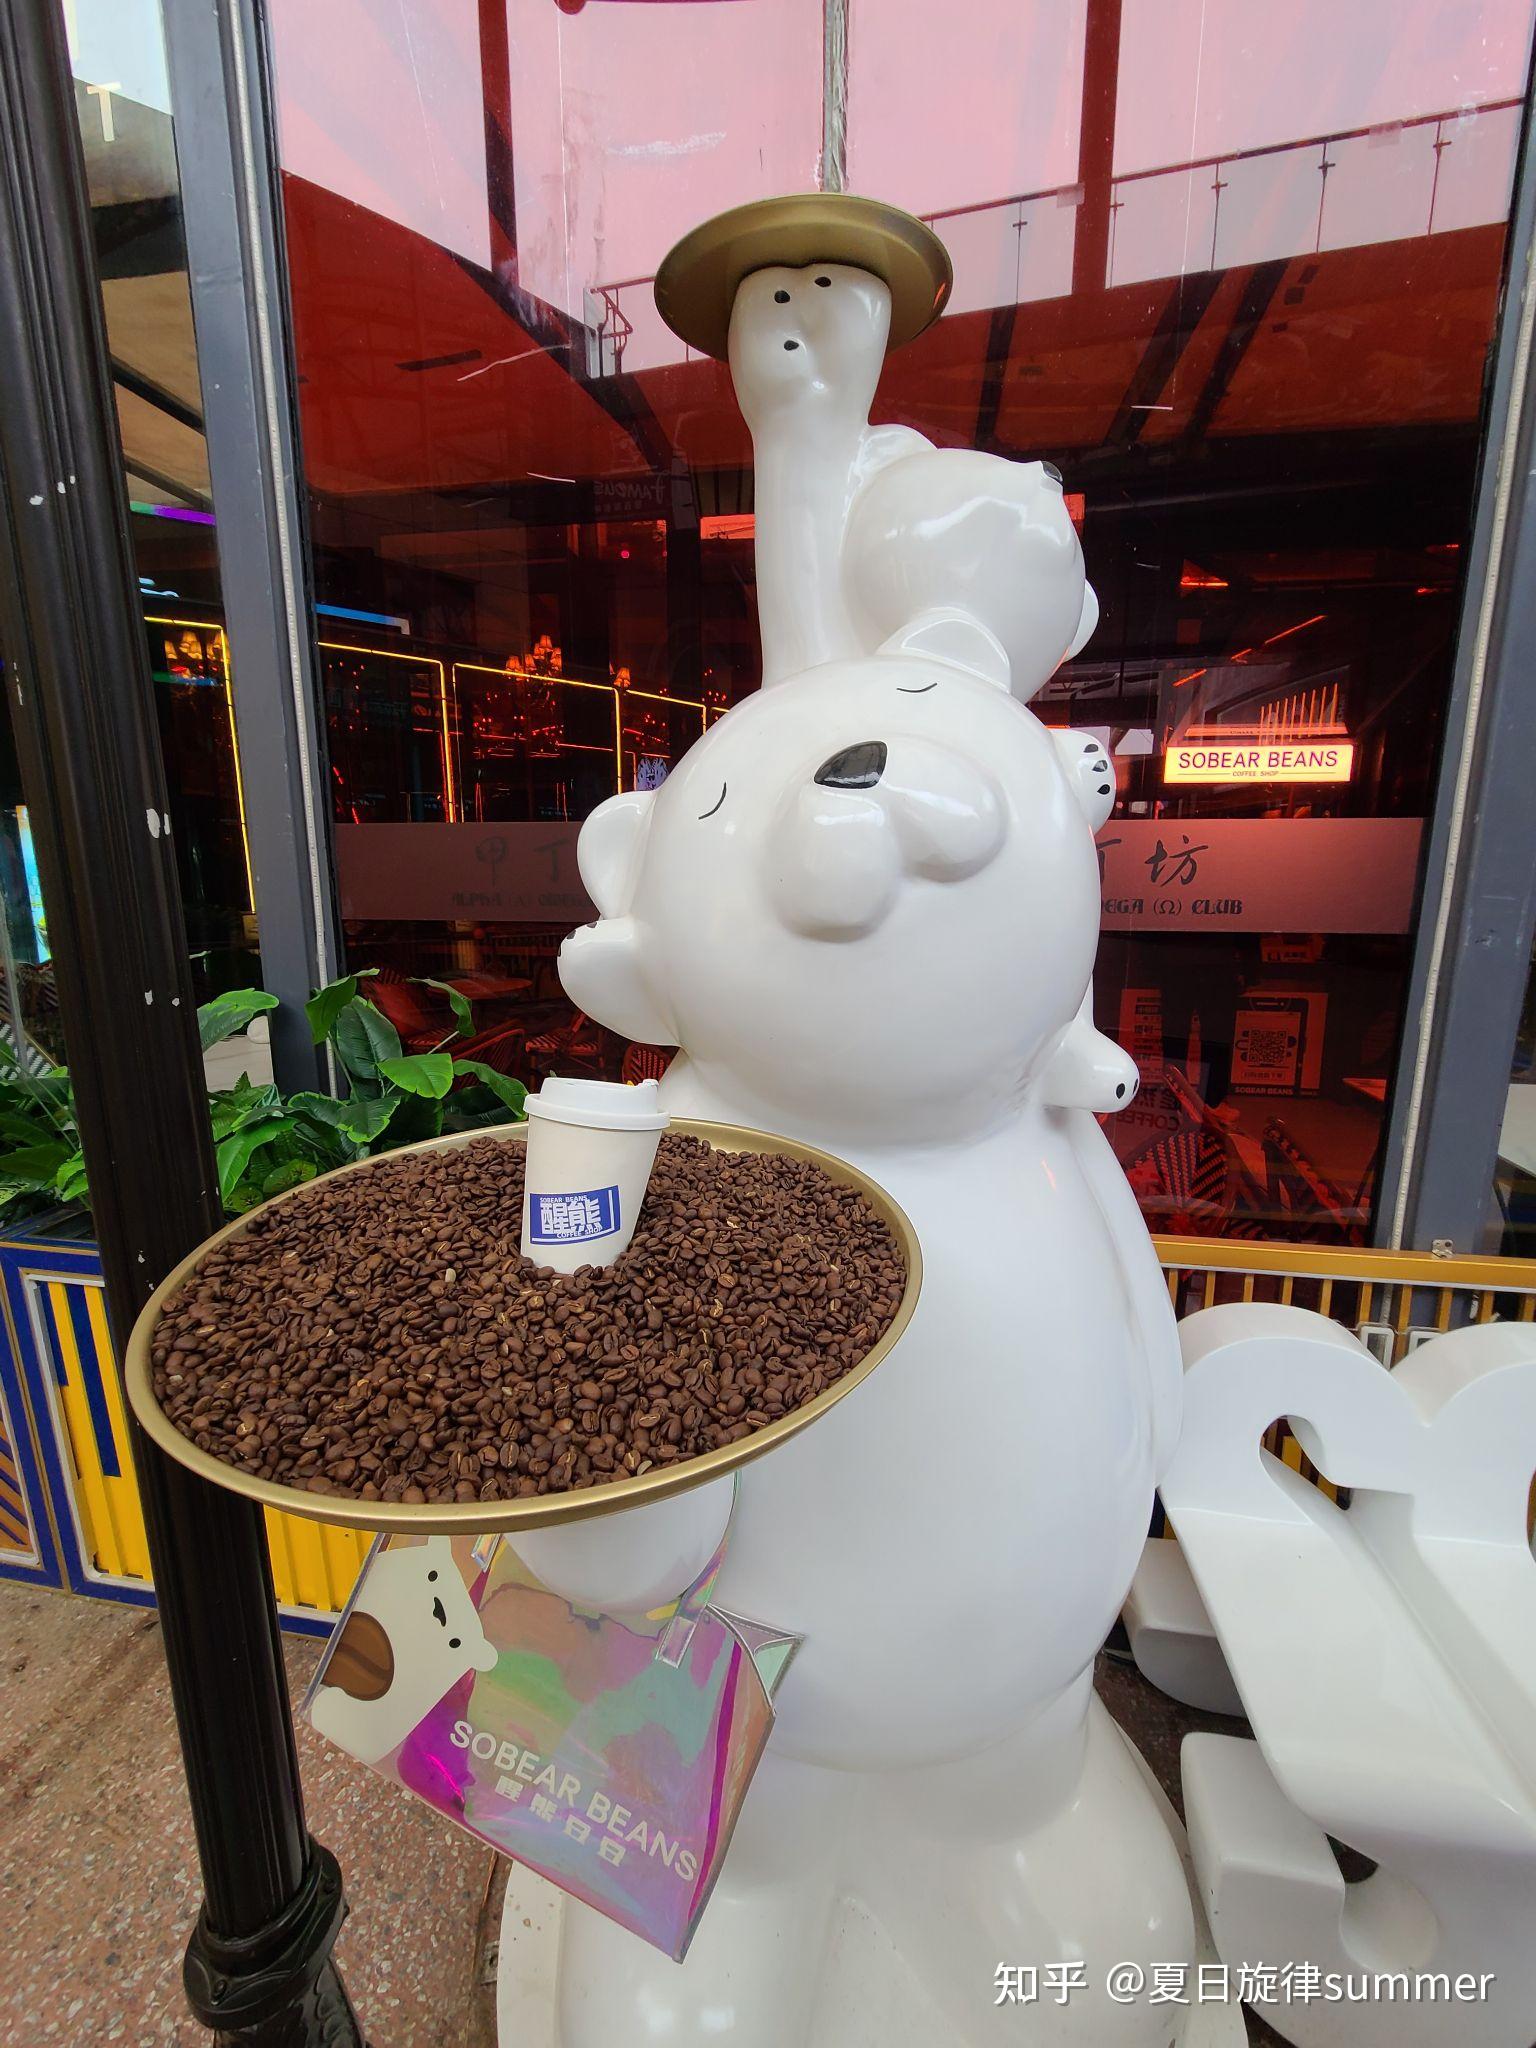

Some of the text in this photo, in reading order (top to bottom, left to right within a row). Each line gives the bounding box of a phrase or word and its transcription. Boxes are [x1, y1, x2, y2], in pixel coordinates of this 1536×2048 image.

[1178, 750, 1338, 769] SOBEAR BEANS
[1101, 898, 1145, 915] EGA
[1191, 898, 1243, 915] CLUB
[556, 1230, 582, 1238] COFFEE
[450, 1720, 697, 1881] SOBEAR BEANS
